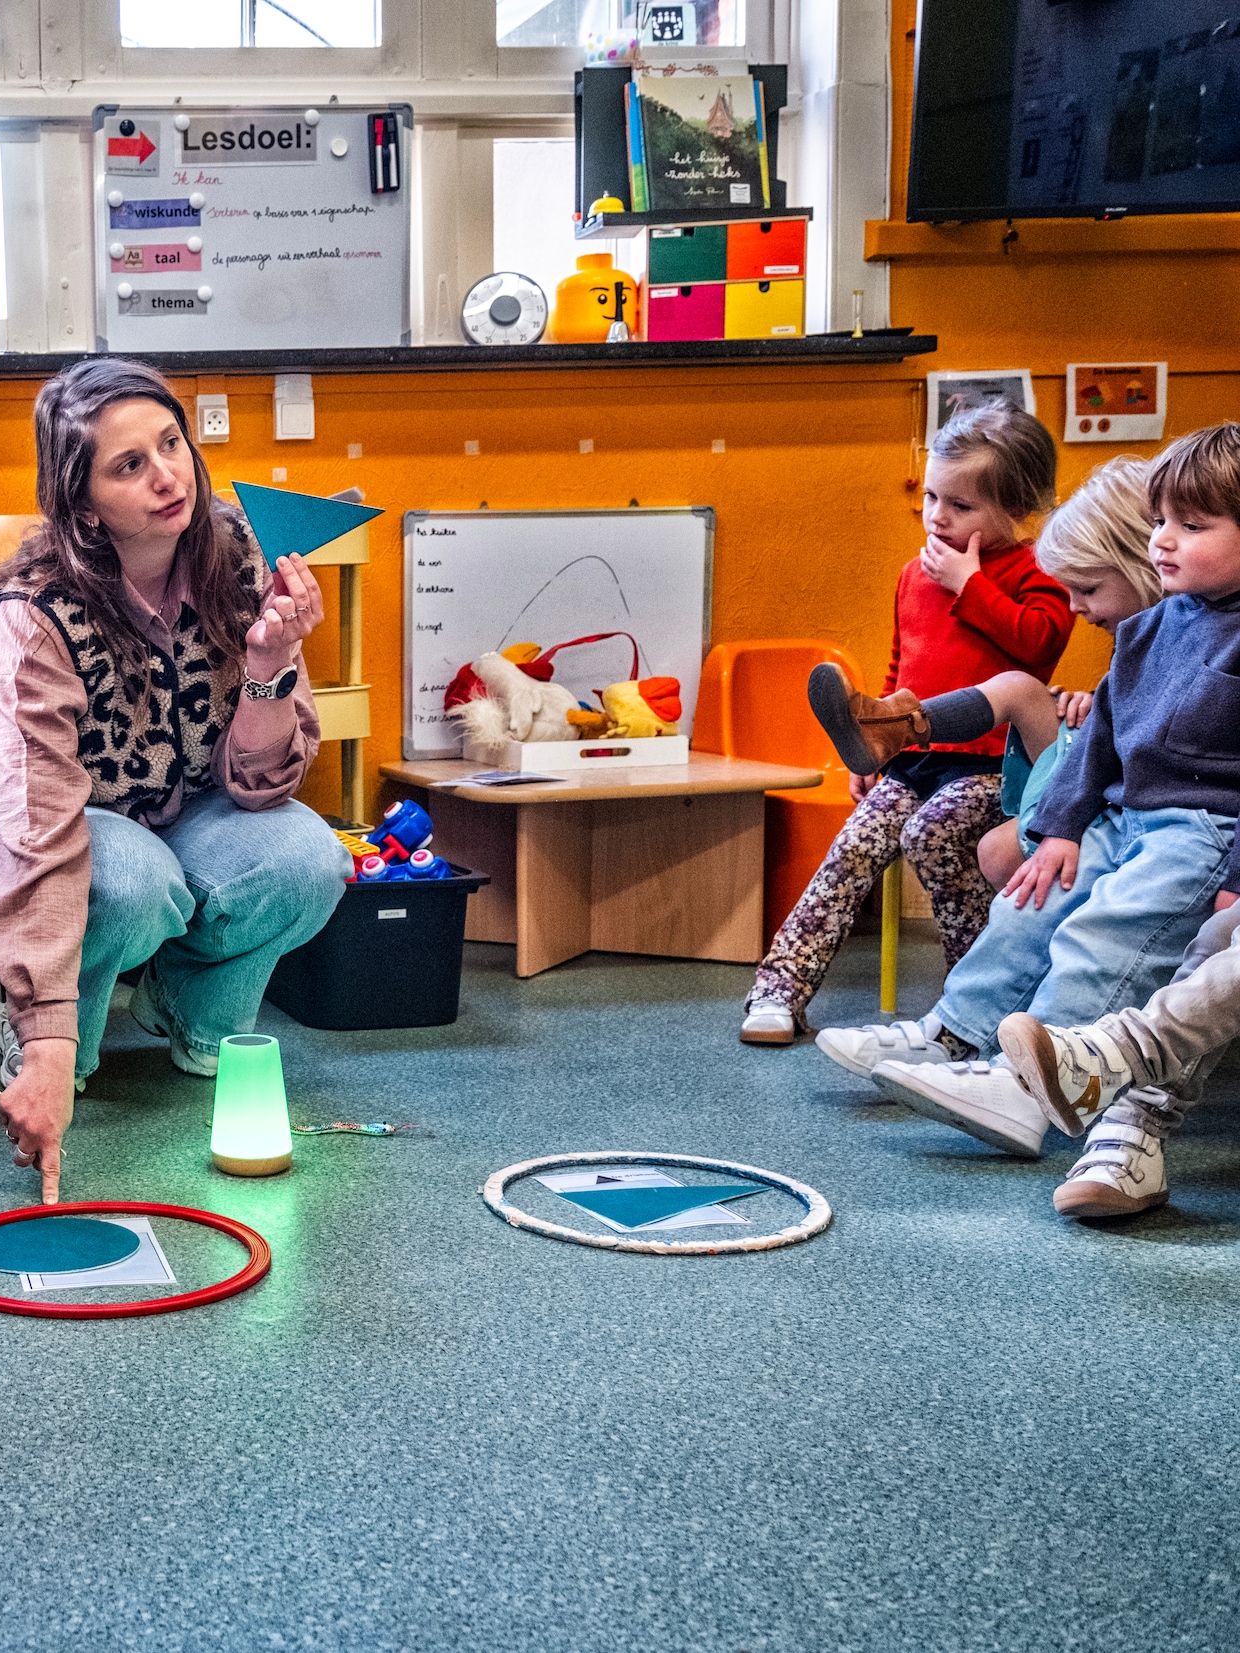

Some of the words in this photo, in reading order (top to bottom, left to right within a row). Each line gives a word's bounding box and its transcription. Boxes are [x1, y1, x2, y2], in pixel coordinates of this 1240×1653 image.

[183, 122, 312, 151] Lesdoel:
[669, 151, 692, 164] het
[696, 150, 730, 167] huisje
[194, 171, 223, 185] kan
[665, 167, 705, 179] zonder
[709, 166, 741, 179] heks
[134, 204, 199, 218] wiskunde
[265, 206, 289, 218] basis
[290, 210, 309, 218] van
[155, 252, 180, 264] taal
[212, 252, 224, 265] de
[151, 297, 194, 308] thema
[471, 293, 478, 301] 50
[485, 336, 493, 344] 35
